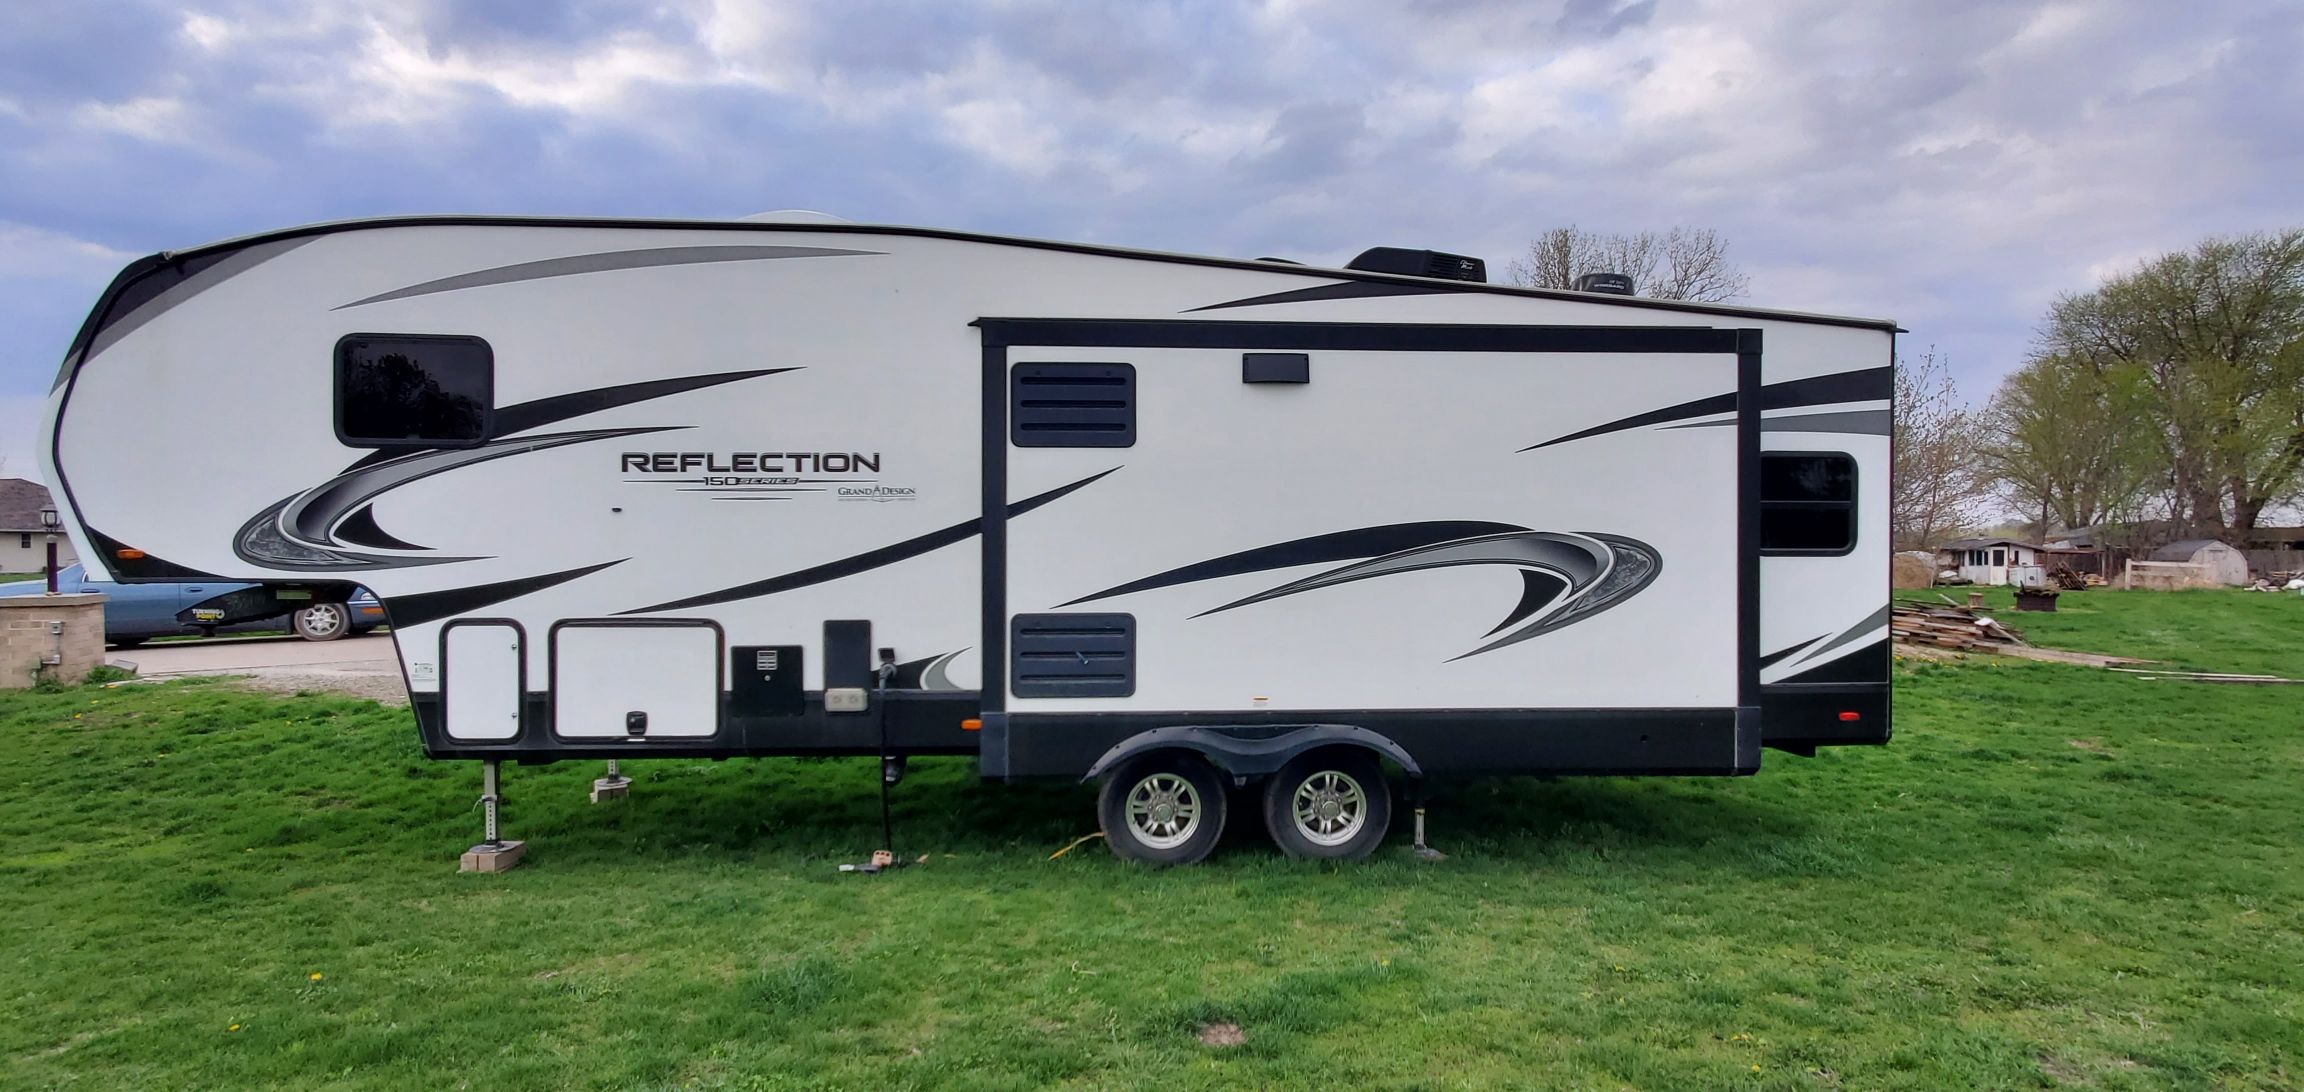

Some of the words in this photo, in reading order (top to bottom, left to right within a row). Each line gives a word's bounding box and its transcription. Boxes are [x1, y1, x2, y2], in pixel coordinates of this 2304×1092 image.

[621, 453, 880, 473] REFLECTION
[703, 476, 739, 486] 150
[738, 477, 800, 485] SERIES
[837, 487, 873, 496] GRAND
[881, 487, 916, 496] DESIGN
